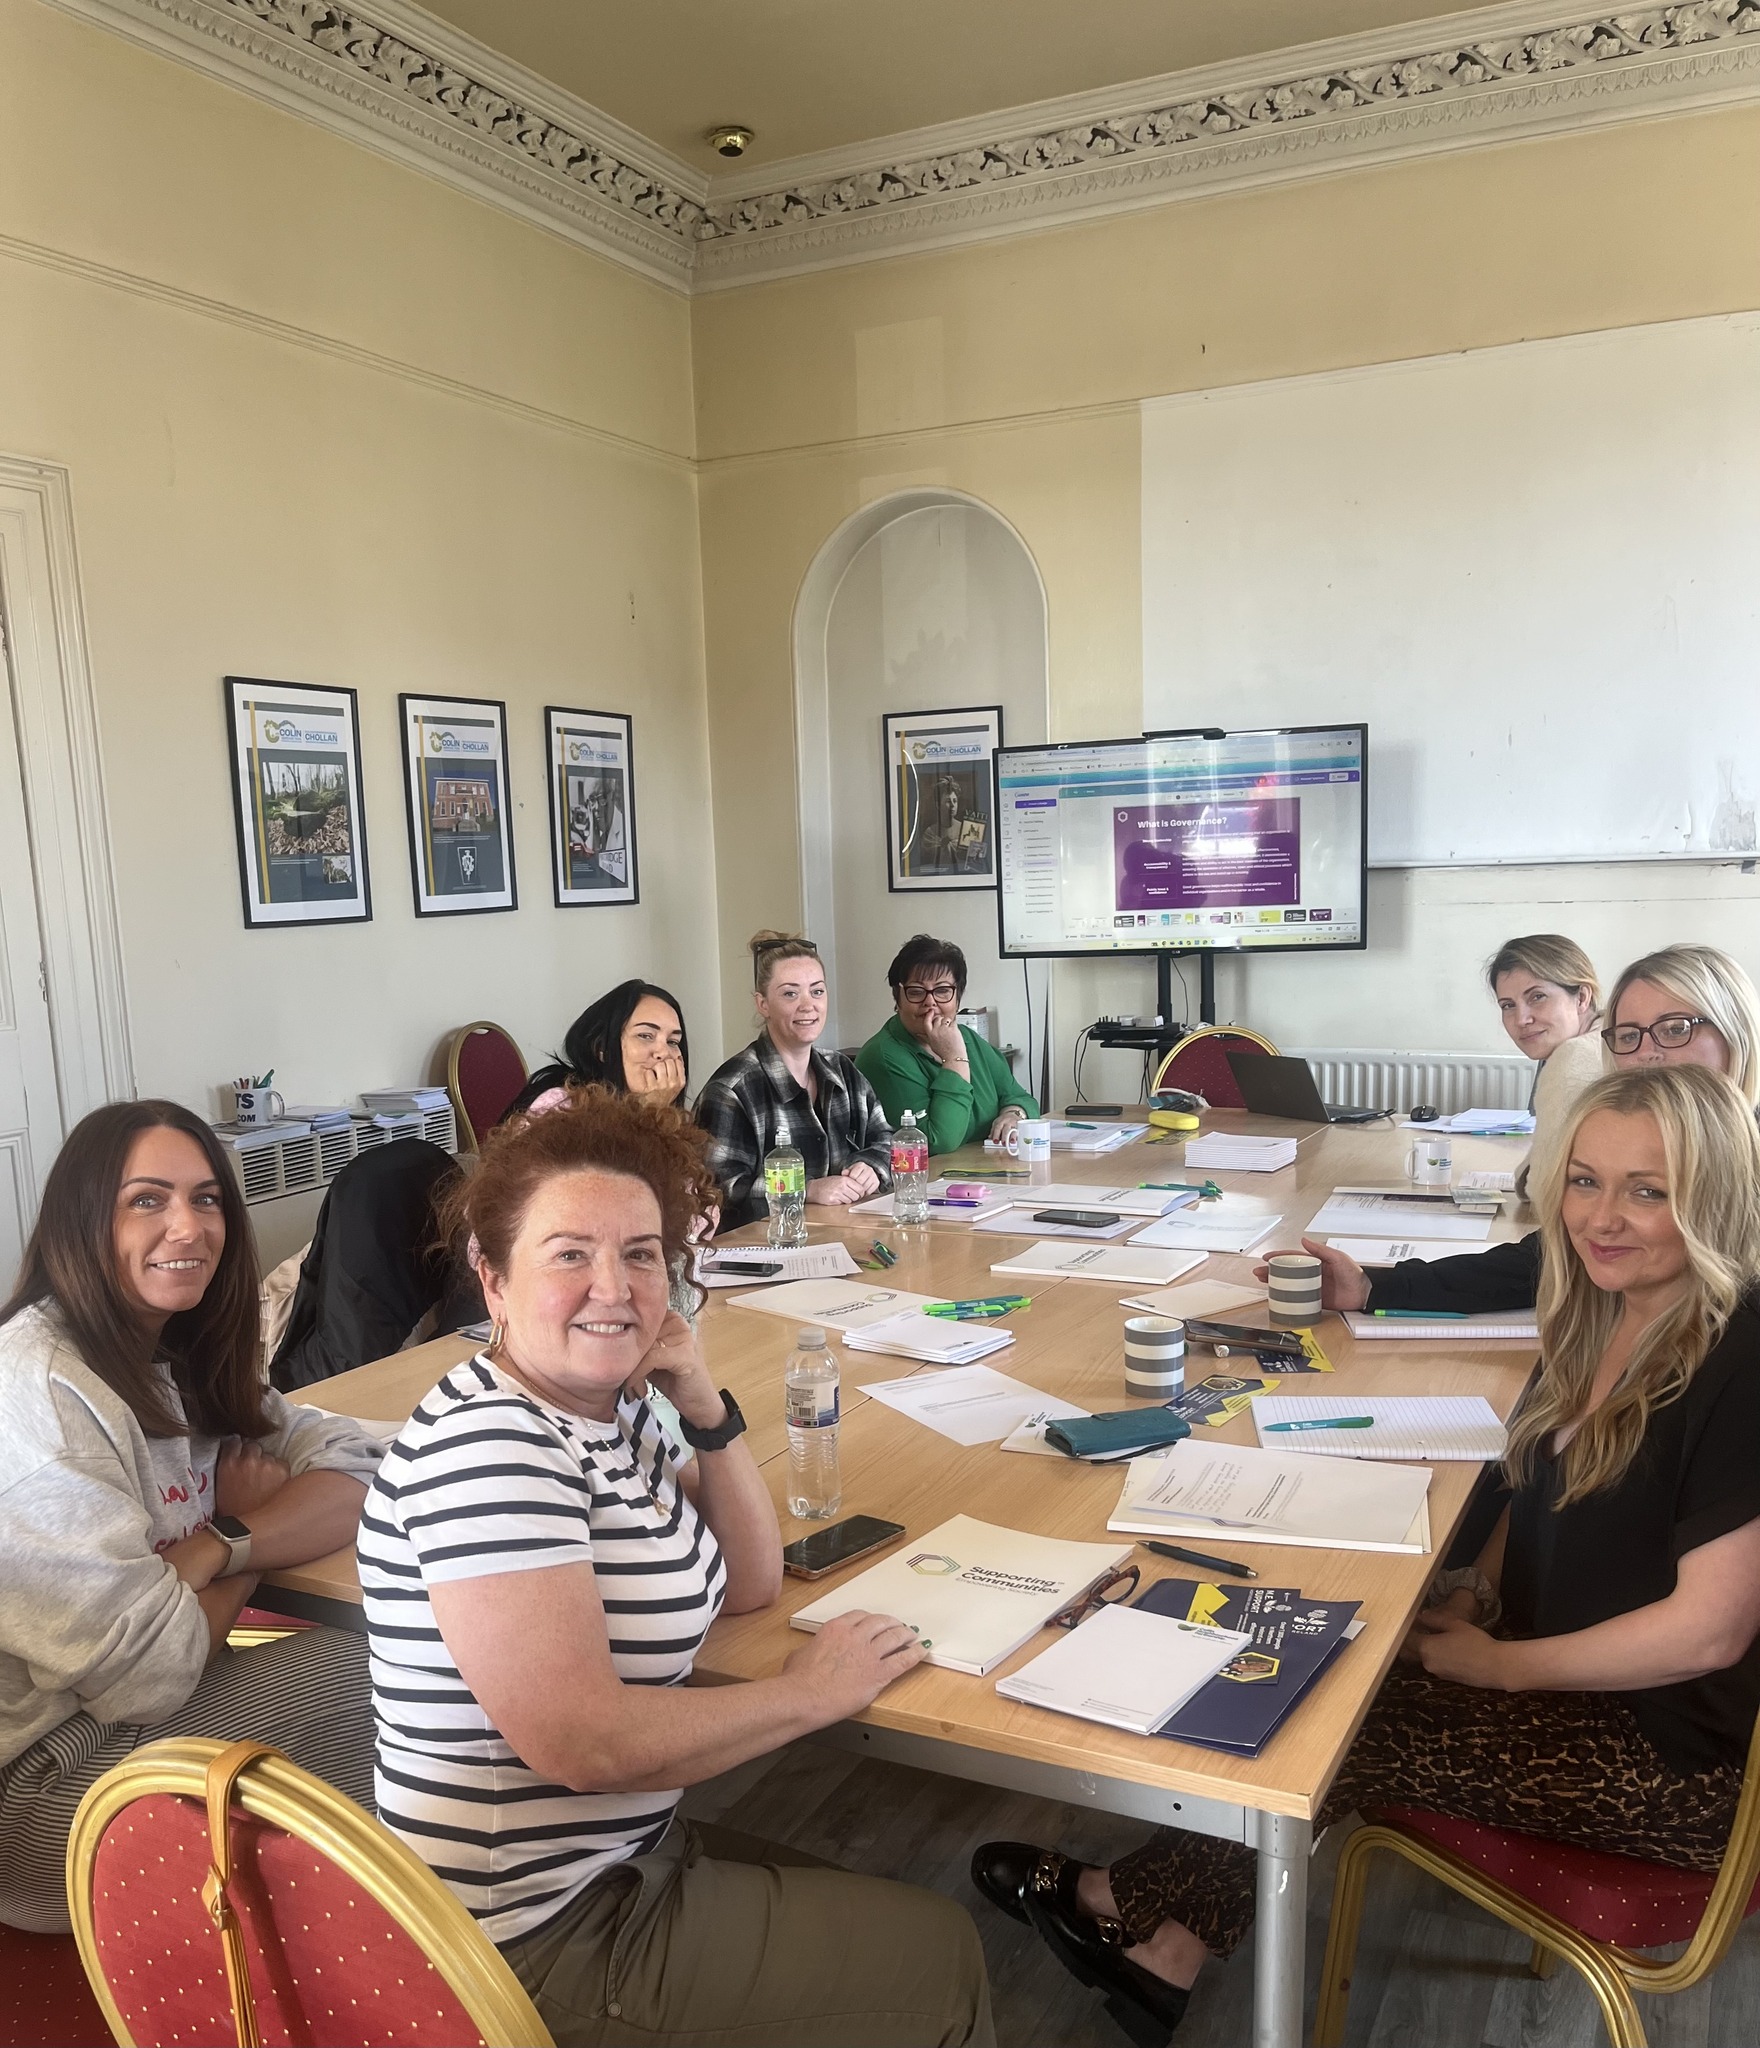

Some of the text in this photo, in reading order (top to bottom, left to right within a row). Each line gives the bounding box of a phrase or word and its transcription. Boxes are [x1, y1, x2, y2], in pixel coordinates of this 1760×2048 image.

[279, 729, 338, 742] COLIN CHOLLAN
[441, 739, 489, 751] COLIN CHOLLAN
[1137, 820, 1160, 829] What
[1169, 816, 1227, 828] Governance?
[969, 1565, 1057, 1587] Supporting
[961, 1572, 1061, 1594] Communities
[1250, 1589, 1264, 1614] SUPPORT
[1291, 1624, 1326, 1632] ORT
